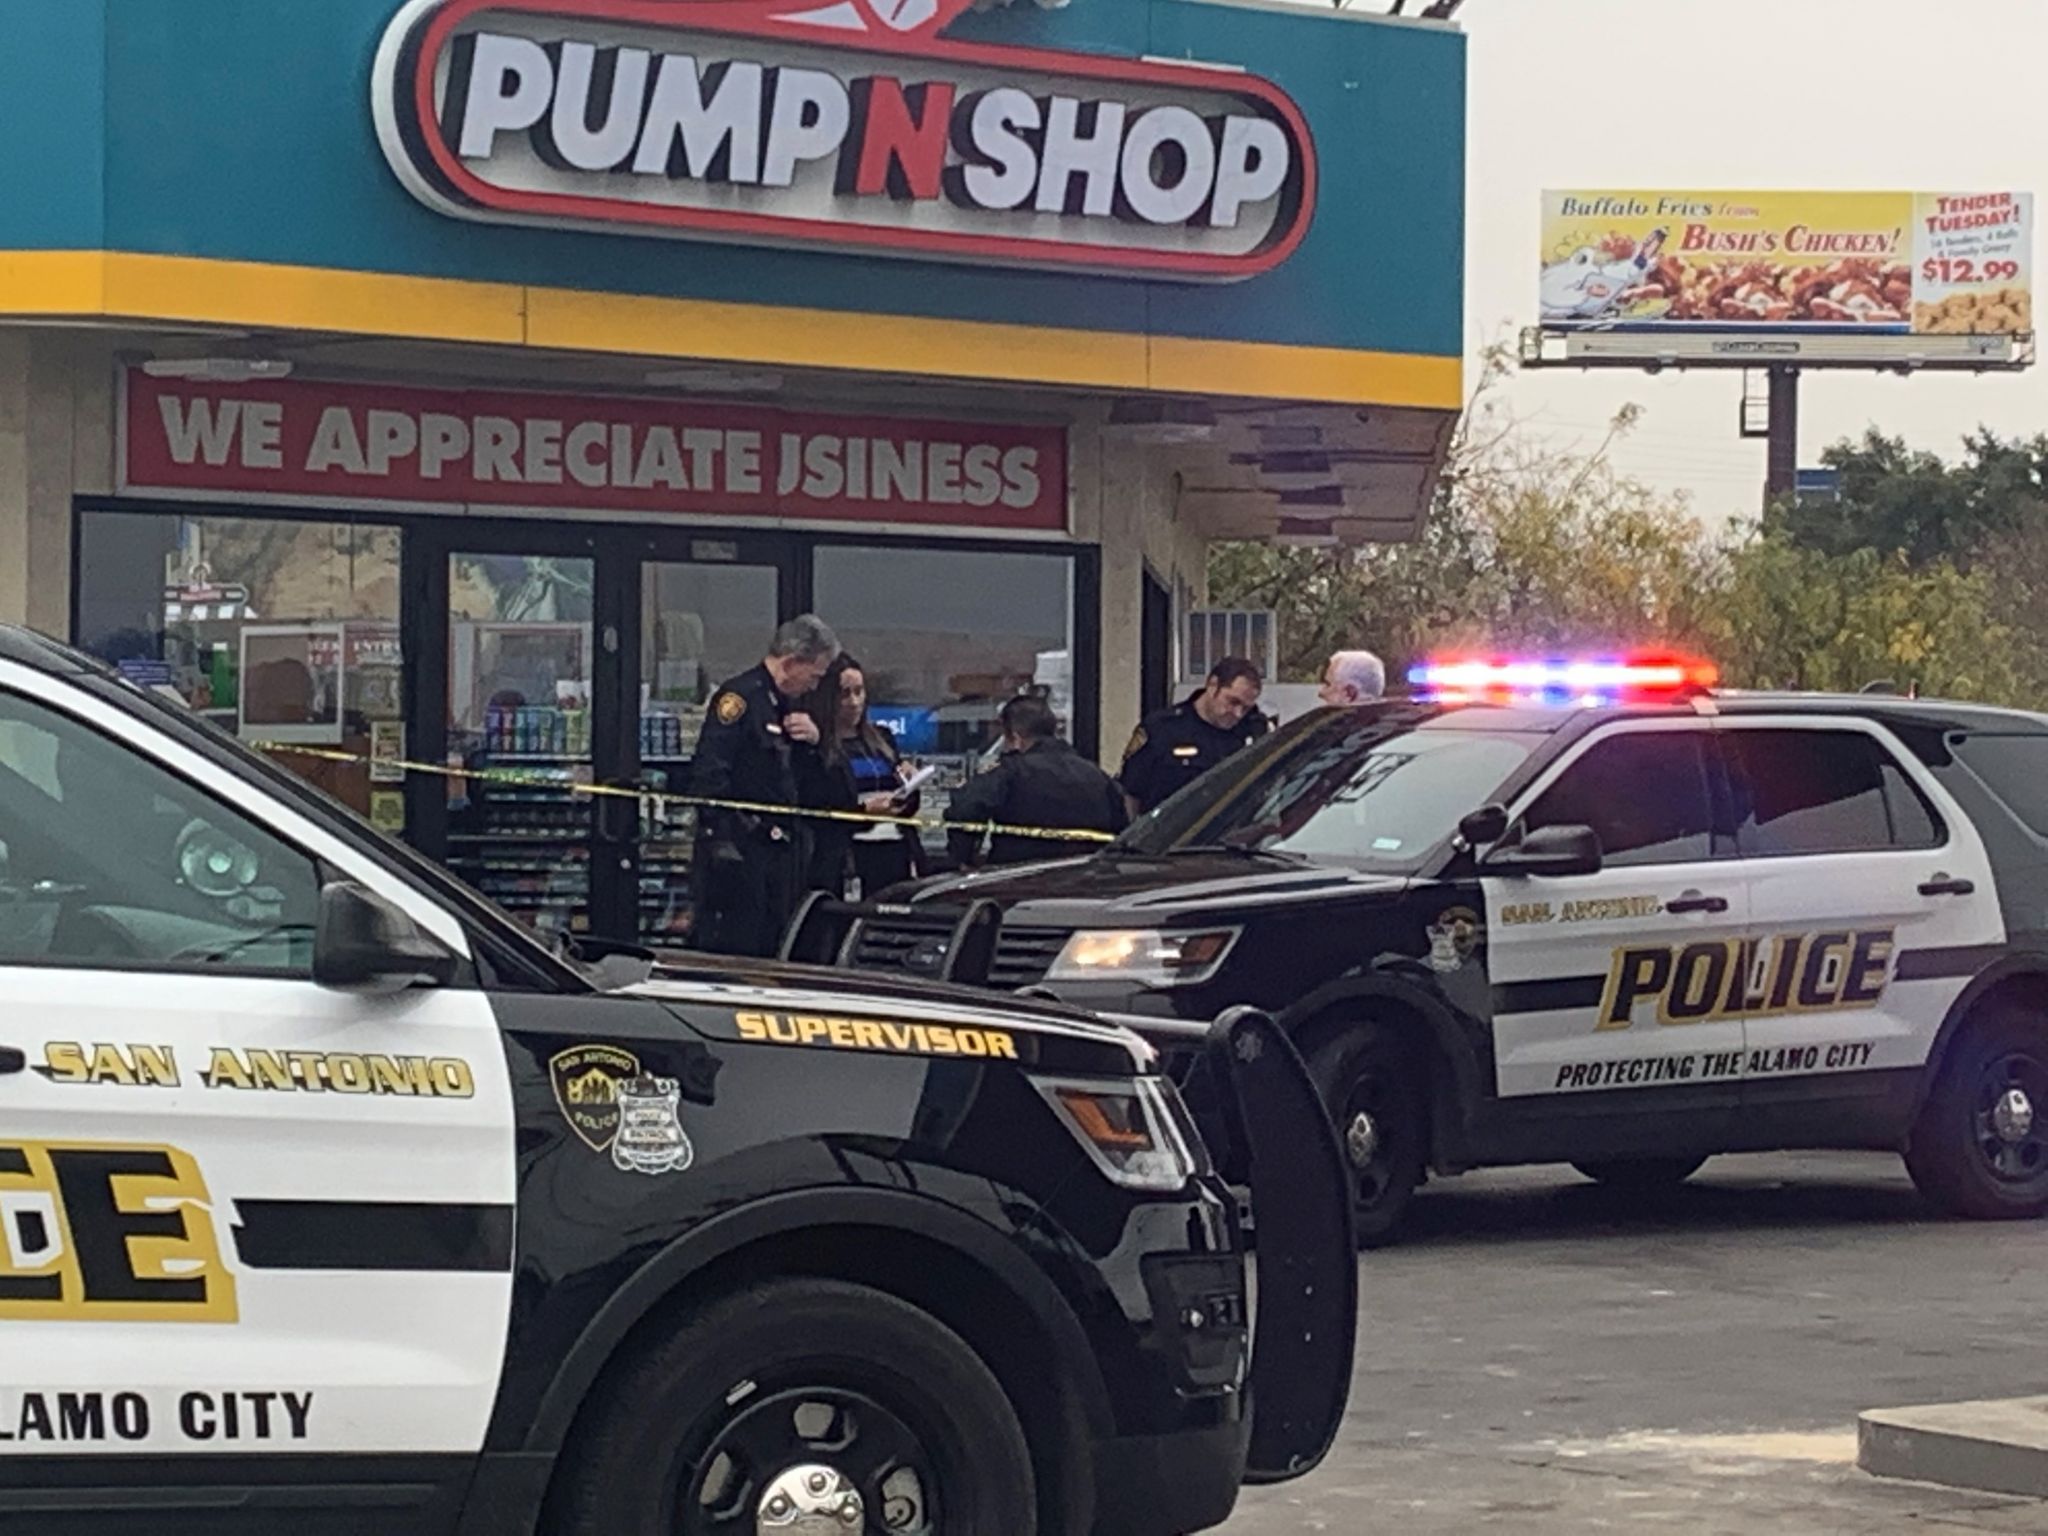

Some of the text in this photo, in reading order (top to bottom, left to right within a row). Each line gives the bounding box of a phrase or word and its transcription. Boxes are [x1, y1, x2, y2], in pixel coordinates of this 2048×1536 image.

[459, 32, 1290, 227] PUMP N SHOP
[1561, 197, 1648, 216] Buffalo
[1656, 197, 1712, 216] Fries
[1926, 204, 2019, 234] TUESDAY!
[1937, 192, 2011, 214] TENDER
[1922, 257, 2019, 283] $12.99
[157, 394, 283, 470] WE
[304, 404, 763, 494] APPRECIATE
[1597, 927, 1898, 1031] POLICE
[736, 1012, 1020, 1060] SUPERVISOR
[38, 1041, 476, 1099] SAN ANTONIO
[1555, 1041, 1876, 1088] PROTECTING THE ALAMO CITY
[0, 1391, 314, 1440] AMO CITY
